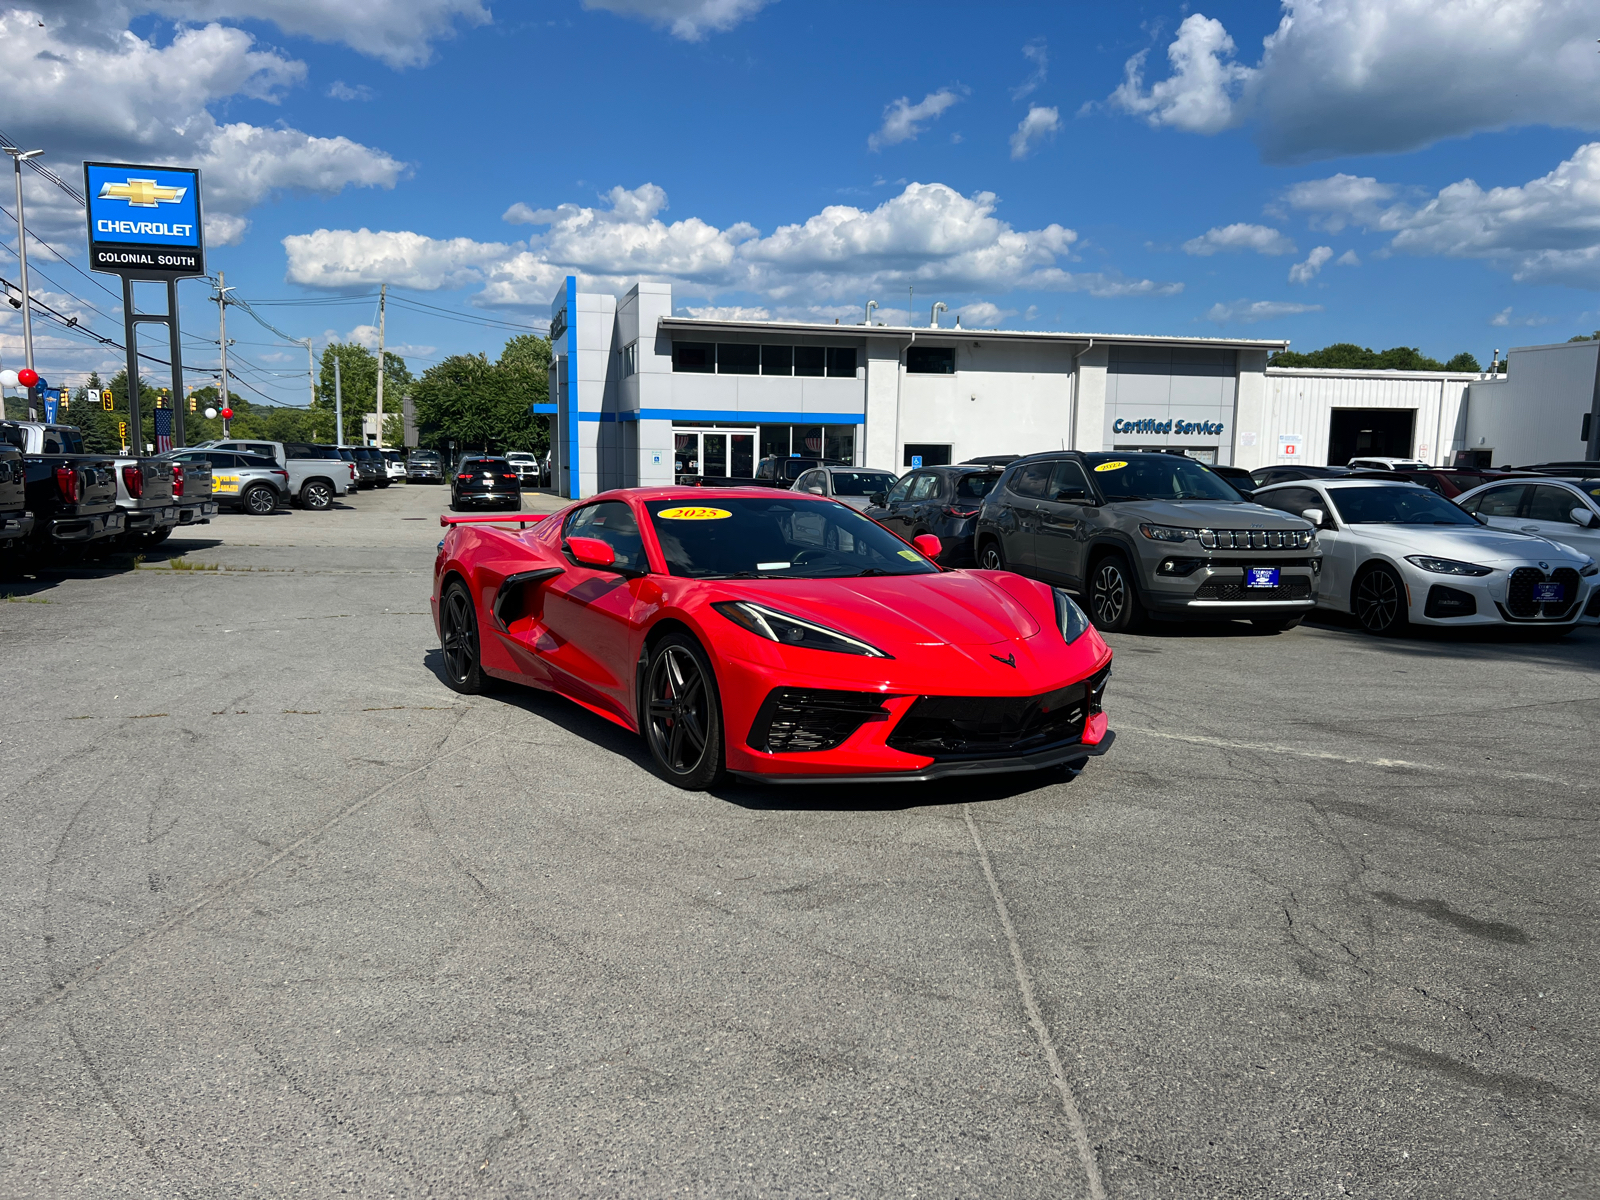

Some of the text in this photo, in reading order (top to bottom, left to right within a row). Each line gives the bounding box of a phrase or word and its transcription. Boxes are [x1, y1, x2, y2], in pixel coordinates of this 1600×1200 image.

[97, 219, 192, 236] CHEVROLET
[98, 252, 195, 266] COLONIAL SOUTH
[1113, 418, 1224, 434] Certified Service
[672, 509, 719, 517] 2025
